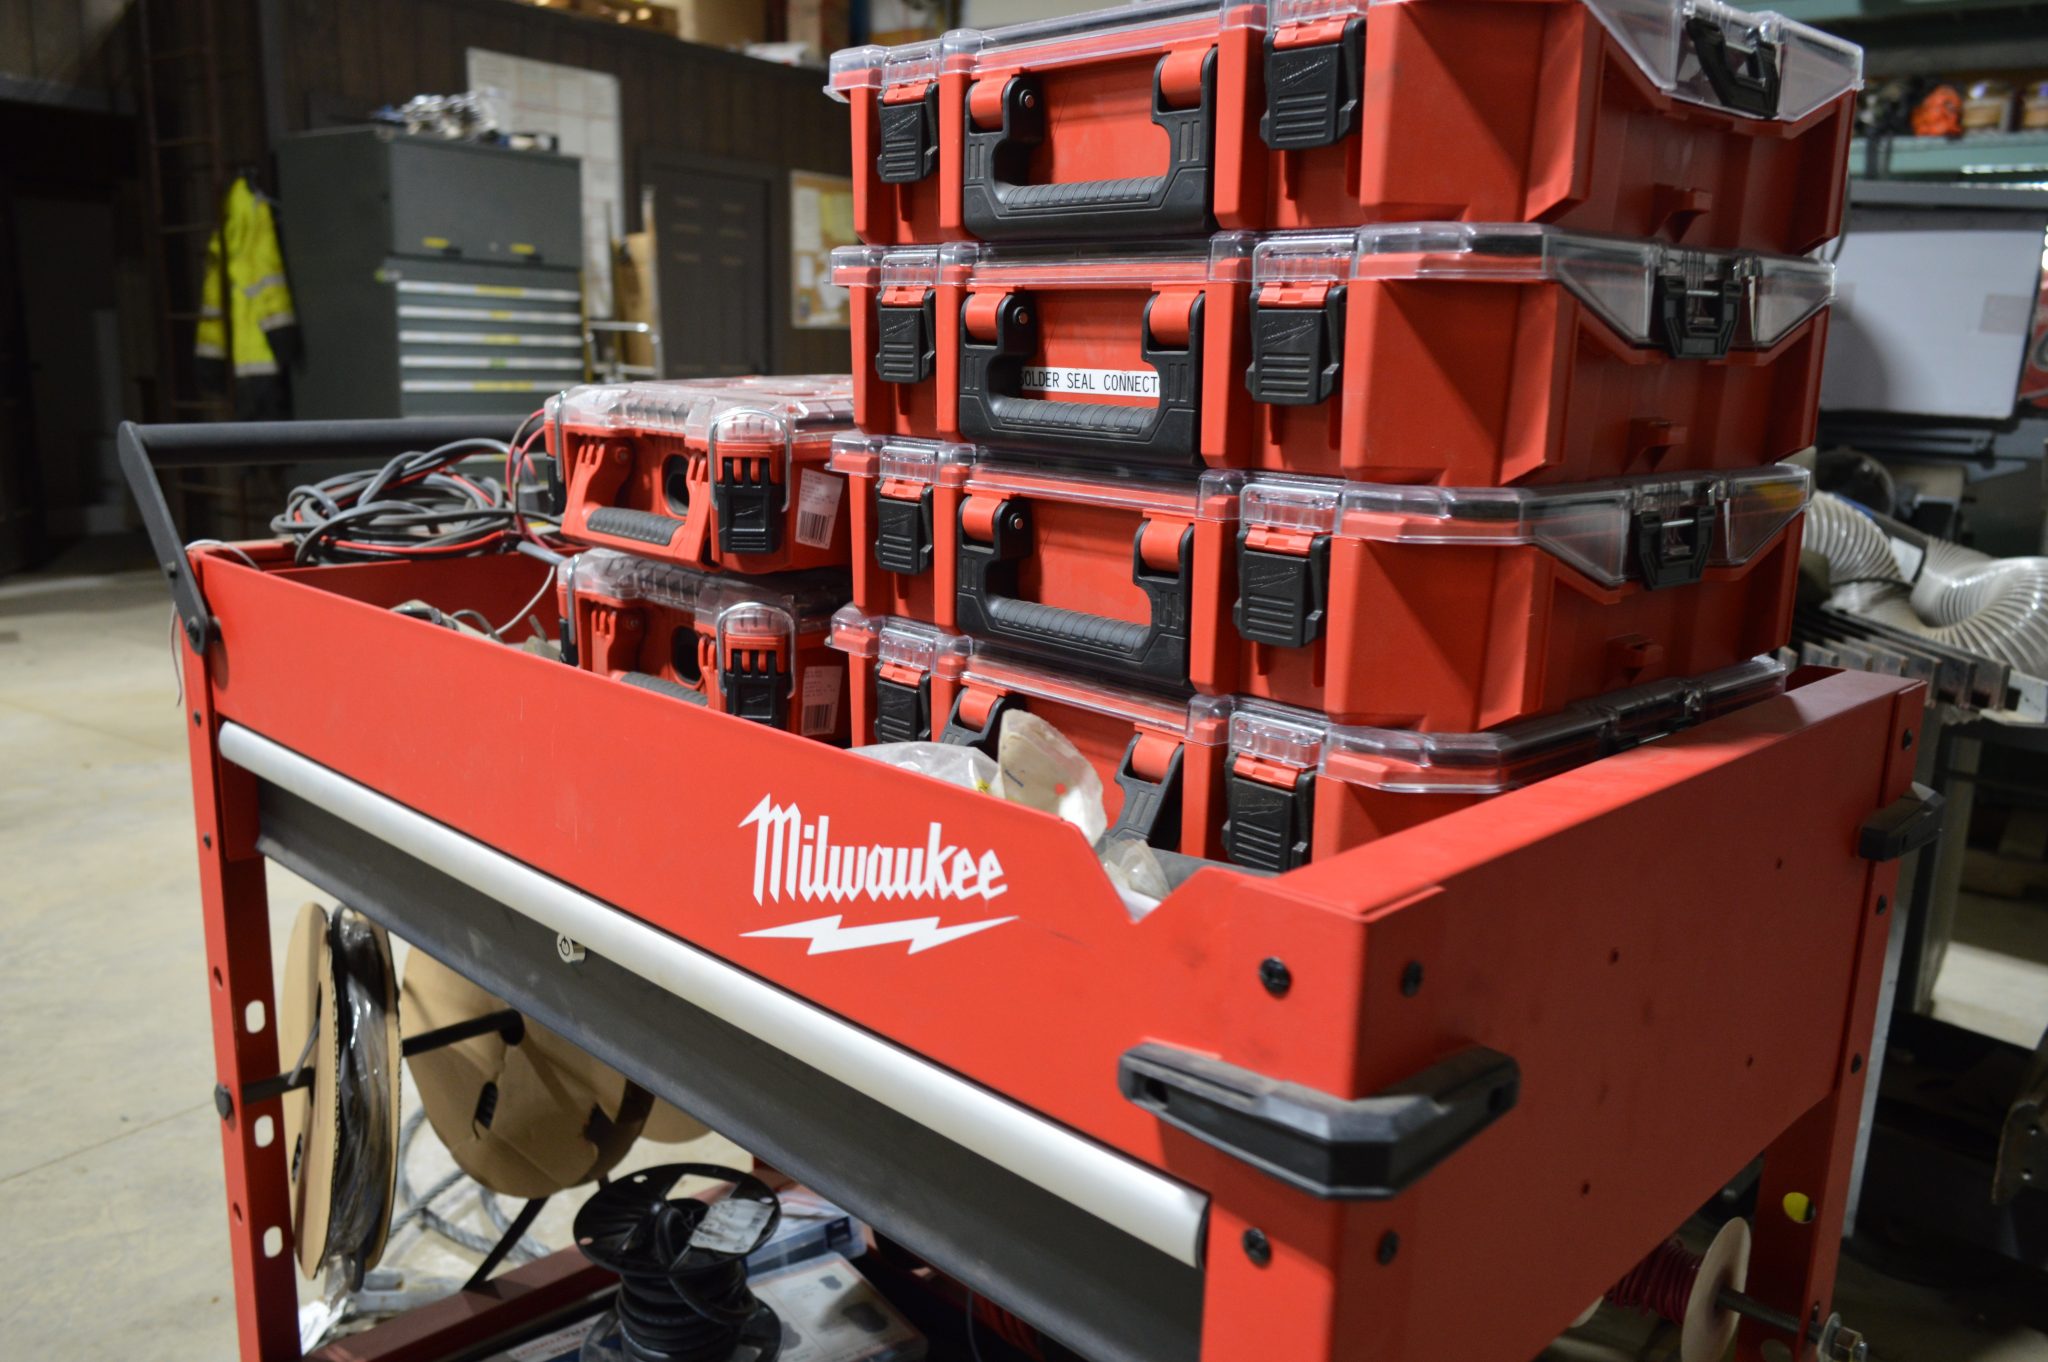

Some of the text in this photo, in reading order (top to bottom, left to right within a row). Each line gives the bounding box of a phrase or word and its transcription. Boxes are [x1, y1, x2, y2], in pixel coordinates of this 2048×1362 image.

[1067, 372, 1095, 390] SEAL
[1104, 374, 1158, 393] CONNECT
[738, 792, 1008, 907] Milwaukee
